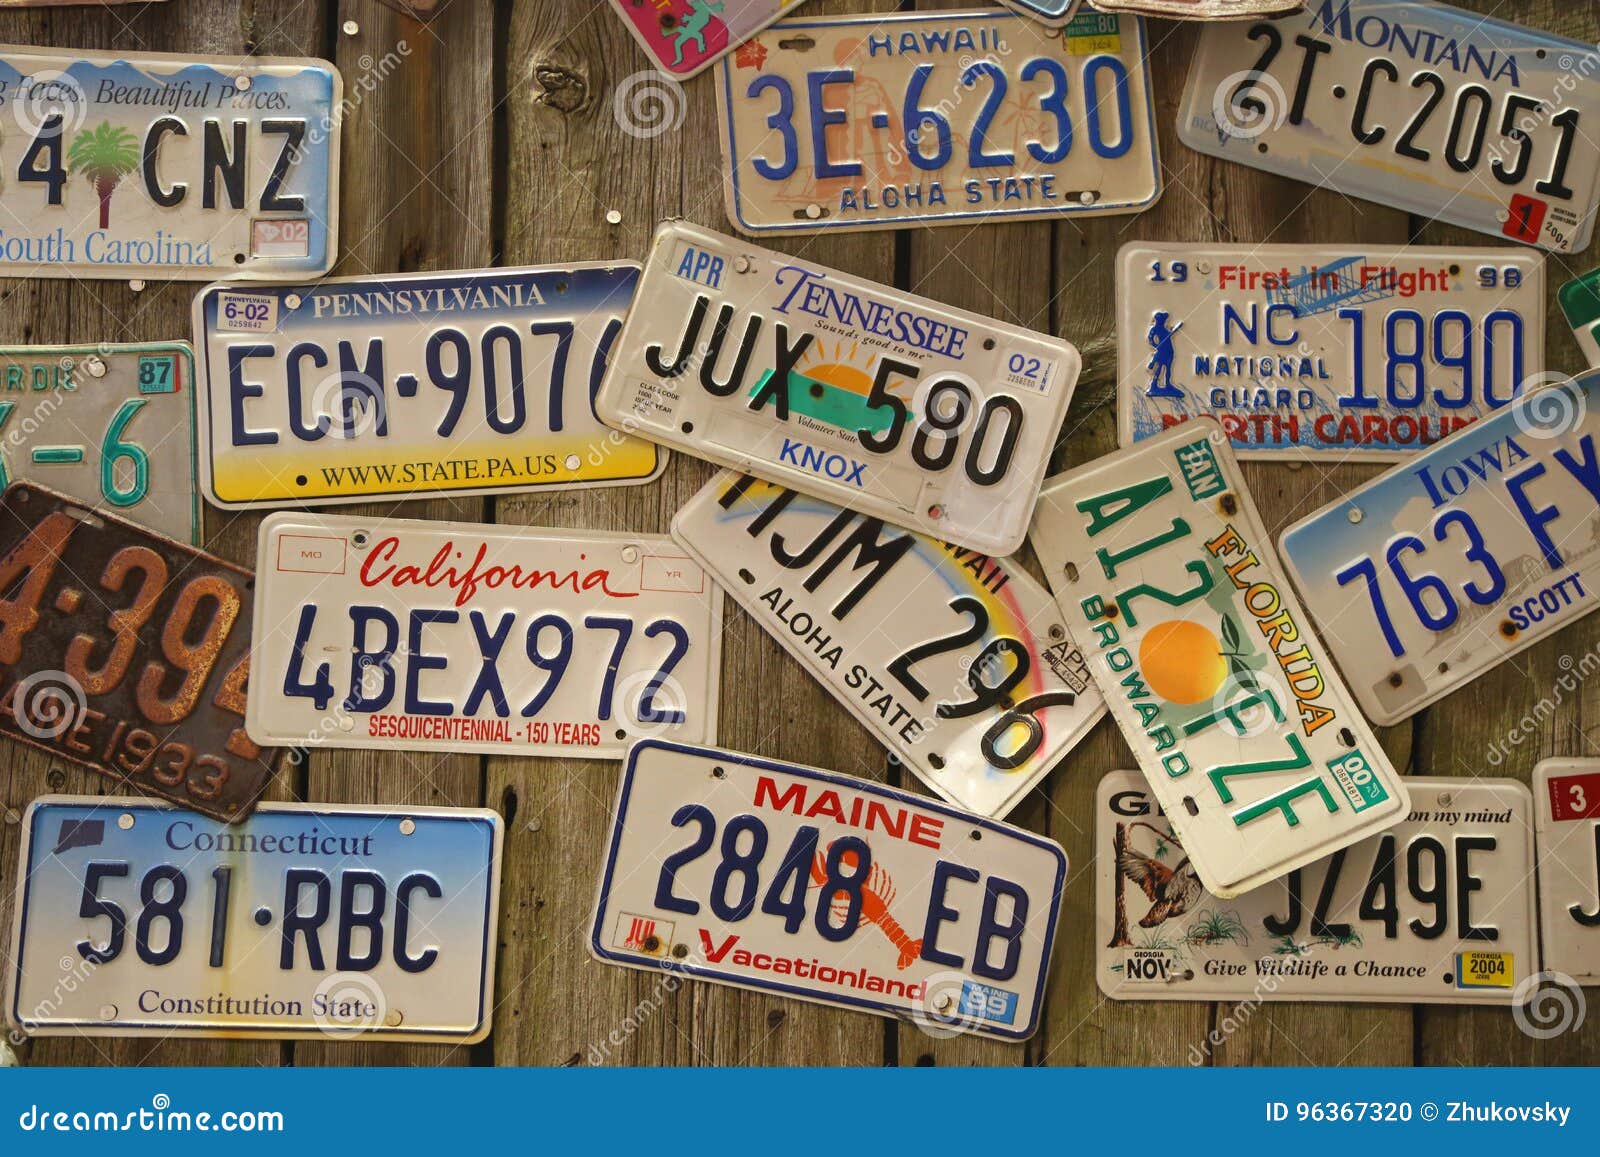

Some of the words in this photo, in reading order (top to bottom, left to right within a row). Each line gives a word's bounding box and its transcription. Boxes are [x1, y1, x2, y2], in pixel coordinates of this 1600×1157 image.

[1097, 14, 1116, 33] 80
[869, 27, 1002, 58] HAWAII
[1308, 0, 1521, 88] MONTANA
[95, 79, 210, 114] Beautiful
[746, 55, 1134, 181] 3E-6230
[142, 115, 307, 212] CNZ
[839, 182, 948, 212] ALOHA
[966, 175, 1058, 204] STATE
[281, 222, 306, 241] 02
[1519, 203, 1534, 236] 1
[1545, 221, 1569, 250] 2002
[84, 230, 214, 266] Carolina
[676, 247, 726, 288] APR
[1150, 260, 1188, 283] 19
[1218, 265, 1290, 291] First
[1359, 264, 1450, 297] Flight
[1478, 264, 1523, 289] 98
[224, 295, 272, 304] PENNSYLVANIA
[225, 302, 269, 321] 6-02
[312, 282, 547, 319] PENNSYLVANIA
[771, 264, 970, 362] TENNESSEE
[814, 319, 859, 340] Sounds
[860, 333, 893, 350] good
[893, 343, 905, 354] to
[1223, 303, 1300, 346] NC
[139, 360, 172, 385] 87
[644, 294, 816, 422] JUX
[1008, 353, 1041, 378] 02
[1195, 355, 1331, 380] NATIONAL
[1336, 308, 1526, 409] 1890
[661, 390, 680, 400] CODE
[1209, 387, 1315, 411] GUARD
[797, 415, 836, 437] Volunteer
[836, 429, 858, 445] State
[856, 357, 1025, 487] 580
[1313, 413, 1480, 445] CAROLI
[320, 454, 557, 488] WWW.STATE.PA.US
[778, 437, 870, 488] KNOX
[1179, 446, 1220, 496] JAN
[1413, 434, 1531, 510] IOWA
[300, 550, 322, 559] MO
[358, 536, 640, 607] California
[1335, 508, 1507, 659] 763
[1508, 571, 1587, 631] SCOTT
[1203, 523, 1337, 737] FLORIDA
[283, 602, 690, 724] 4BEX972
[759, 586, 847, 671] ALOHA
[843, 664, 925, 746] STATE
[1076, 475, 1215, 628] A12
[1183, 688, 1341, 828] FZF
[886, 595, 1077, 771] 296
[1080, 596, 1192, 779] BROWARD
[368, 714, 512, 743] SESQUICENTENNIAL
[526, 720, 549, 745] 150
[553, 721, 601, 746] YEARS
[102, 720, 230, 800] 1933
[1344, 756, 1373, 786] 00
[752, 775, 945, 851] MAINE
[1568, 784, 1588, 813] 3
[1433, 810, 1463, 827] my
[1463, 808, 1513, 824] mind
[165, 820, 374, 857] Connecticut
[653, 803, 873, 943] 2848
[919, 859, 1031, 982] EB
[698, 927, 928, 1002] Vacationland
[1127, 958, 1171, 980] NOV
[1133, 950, 1165, 958] GEORGIA
[1203, 958, 1247, 978] Give
[1253, 957, 1330, 979] Wildlife
[1334, 964, 1348, 978] a
[1353, 960, 1428, 979] Chance
[1469, 959, 1506, 975] 2004
[1471, 952, 1503, 960] GEORGIA
[137, 989, 305, 1018] Constitution
[312, 992, 377, 1020] State
[966, 991, 1008, 1016] 99
